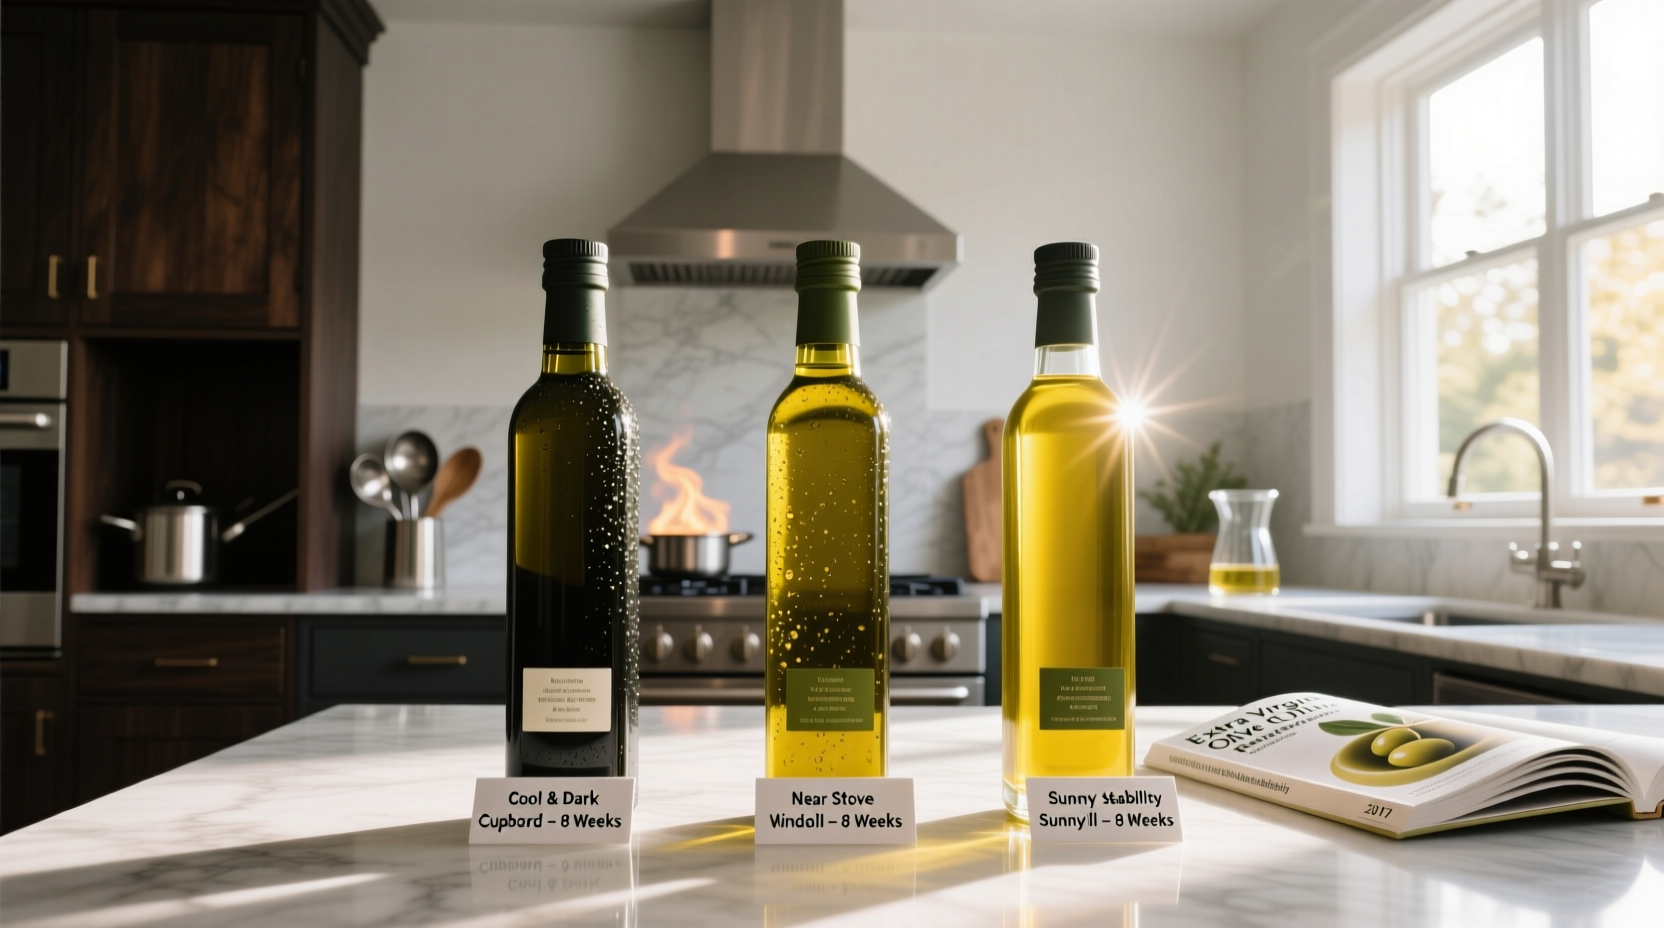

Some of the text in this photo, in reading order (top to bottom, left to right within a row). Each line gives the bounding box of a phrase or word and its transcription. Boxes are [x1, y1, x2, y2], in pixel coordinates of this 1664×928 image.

[1185, 717, 1250, 745] Extra
[508, 790, 600, 806] Cool & Dark
[792, 791, 875, 806] Near Stove
[1048, 790, 1097, 808] Sunny
[1363, 803, 1393, 819] 2017
[560, 814, 570, 828] 8
[574, 813, 622, 828] Weeks
[841, 814, 850, 828] 8
[855, 813, 903, 828] Weeks
[1115, 813, 1124, 827] 8
[1127, 812, 1175, 827] Weeks
